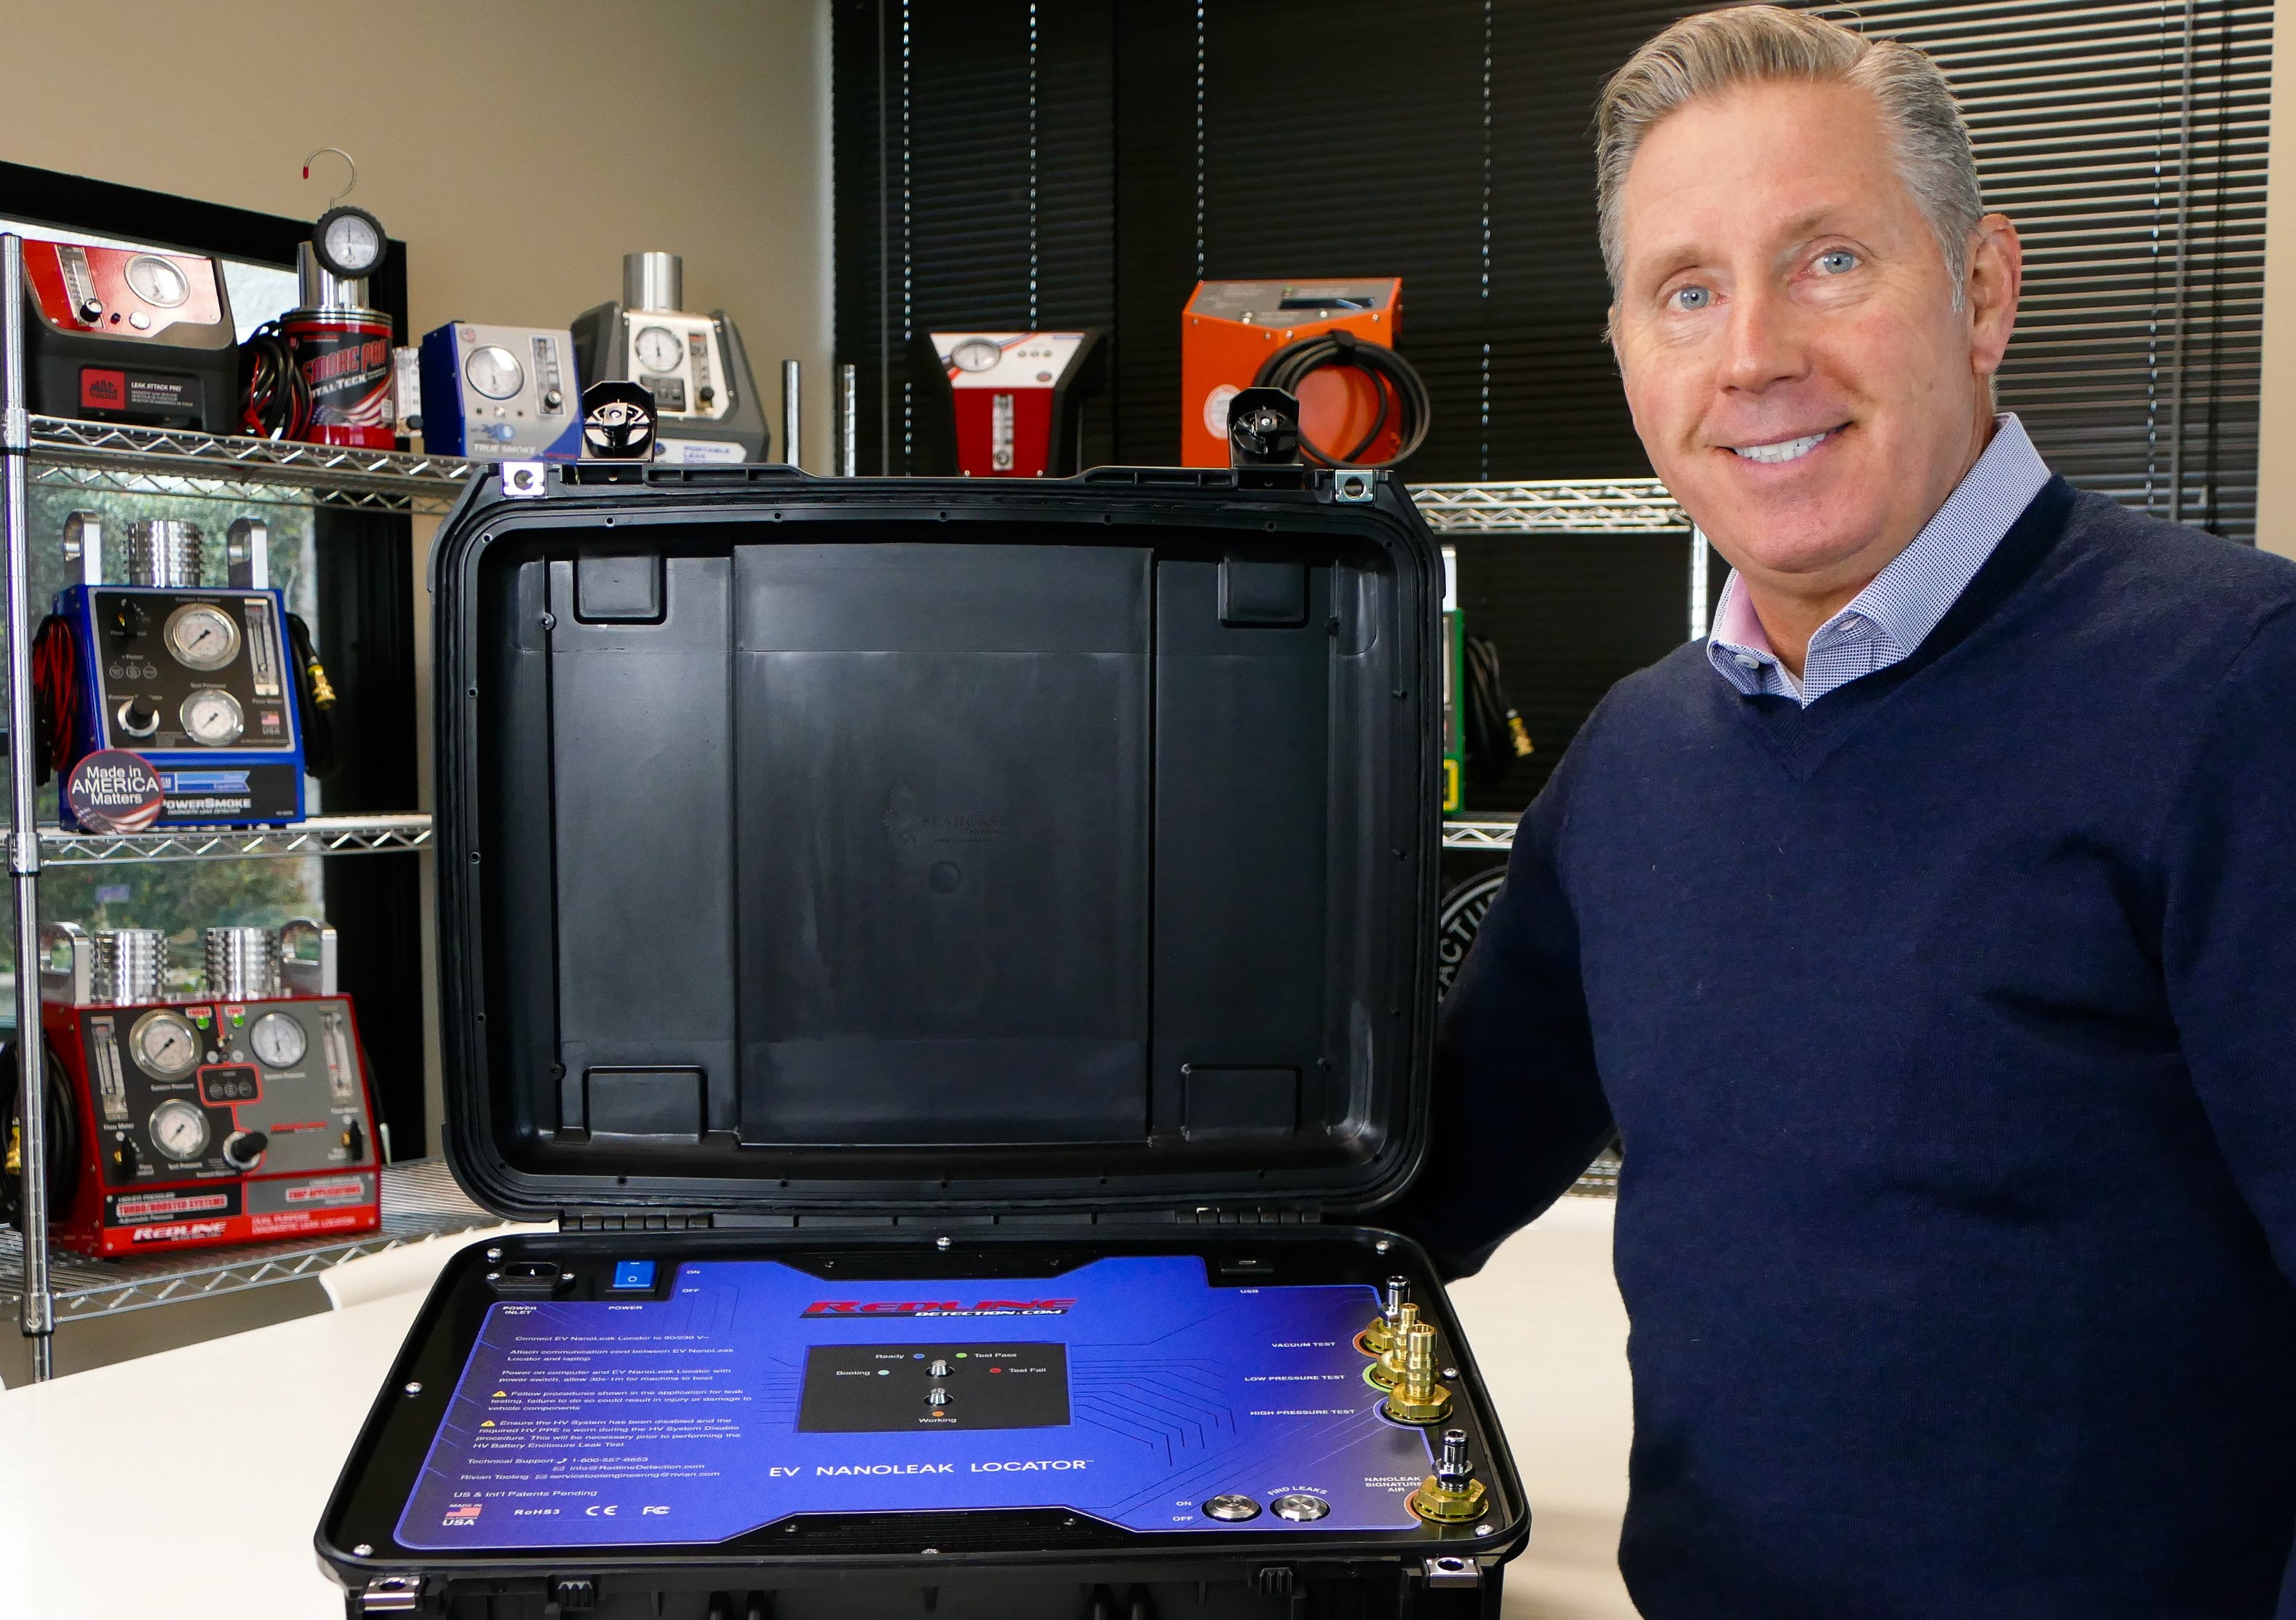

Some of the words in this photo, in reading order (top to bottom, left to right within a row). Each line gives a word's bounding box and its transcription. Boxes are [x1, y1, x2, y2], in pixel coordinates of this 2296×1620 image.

[474, 444, 499, 452] TRUE
[502, 446, 536, 454] SMOKE
[87, 766, 125, 778] Made
[129, 766, 141, 777] in
[72, 777, 159, 795] AMERICA
[91, 793, 143, 805] Matters
[133, 1222, 227, 1241] REDLINE
[804, 1298, 1079, 1313] REDLINE
[769, 1467, 801, 1477] EV
[817, 1464, 954, 1475] NANOLEAK
[1267, 1487, 1290, 1496] FIND
[1292, 1486, 1327, 1494] LEAKS
[585, 1505, 618, 1517] CE
